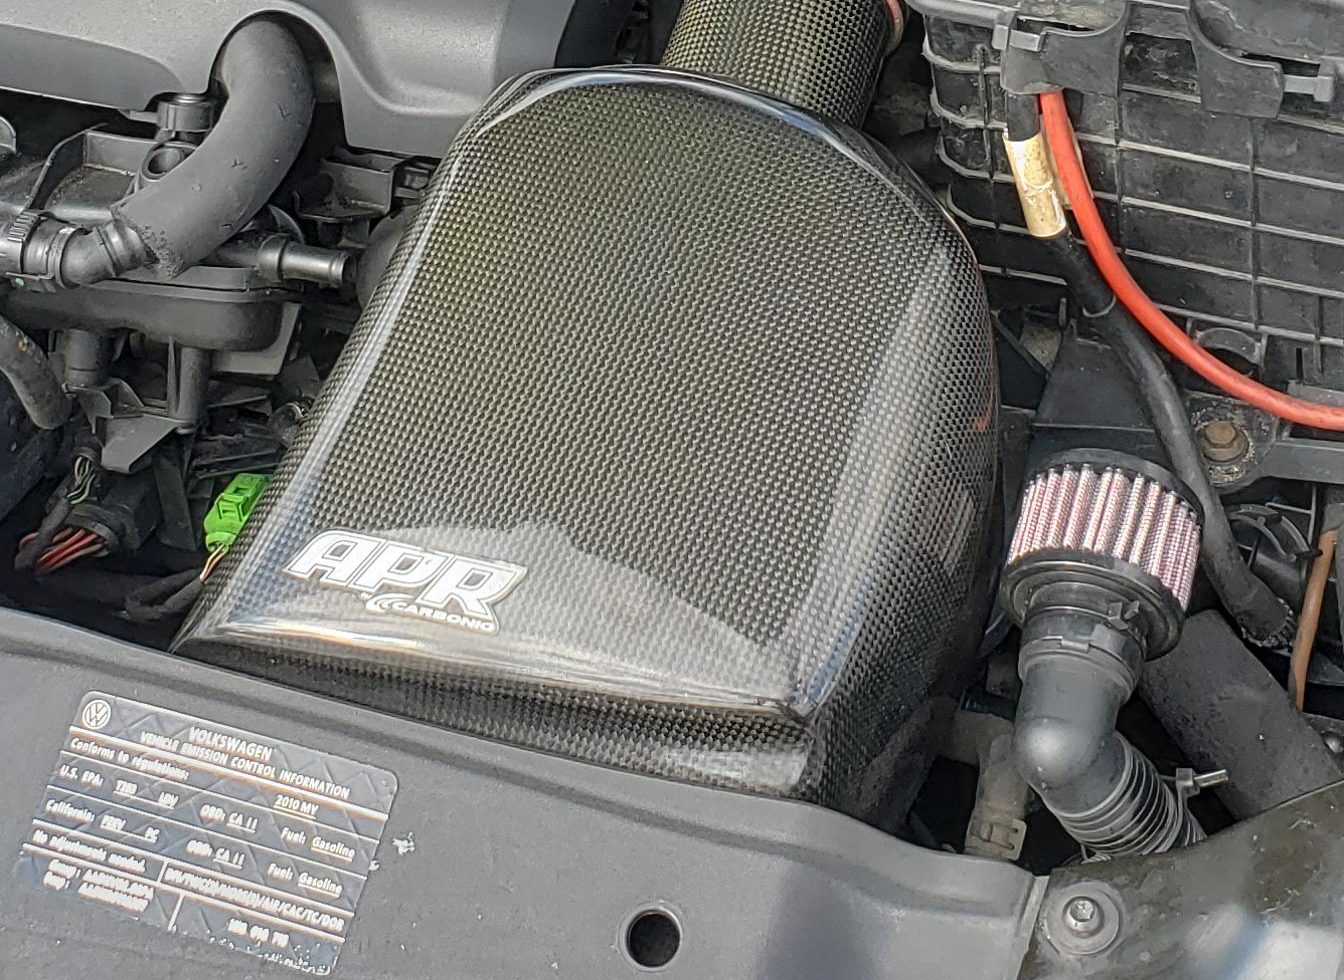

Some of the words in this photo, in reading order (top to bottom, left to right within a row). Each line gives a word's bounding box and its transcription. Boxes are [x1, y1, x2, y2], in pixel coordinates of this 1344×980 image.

[283, 529, 528, 620] APR
[392, 602, 496, 632] CARBONIO
[70, 737, 115, 759] Conforms
[117, 750, 129, 763] to
[188, 726, 272, 761] VOLKSWAGEN
[59, 764, 79, 779] U.S.
[82, 770, 104, 786] EPA:
[139, 731, 178, 751] VEHICLE
[180, 742, 228, 764] EMISSION
[231, 756, 277, 778] CONTROL
[280, 769, 349, 798] INFORMATION
[45, 798, 96, 823] California:
[275, 795, 299, 810] 2010
[301, 802, 317, 815] MY
[229, 812, 244, 825] CA
[32, 829, 48, 844] No
[281, 827, 305, 843] Fuel:
[312, 836, 355, 857] Gasoline
[215, 847, 231, 861] CA
[268, 862, 293, 880] Fuel:
[299, 871, 343, 894] Gasoline
